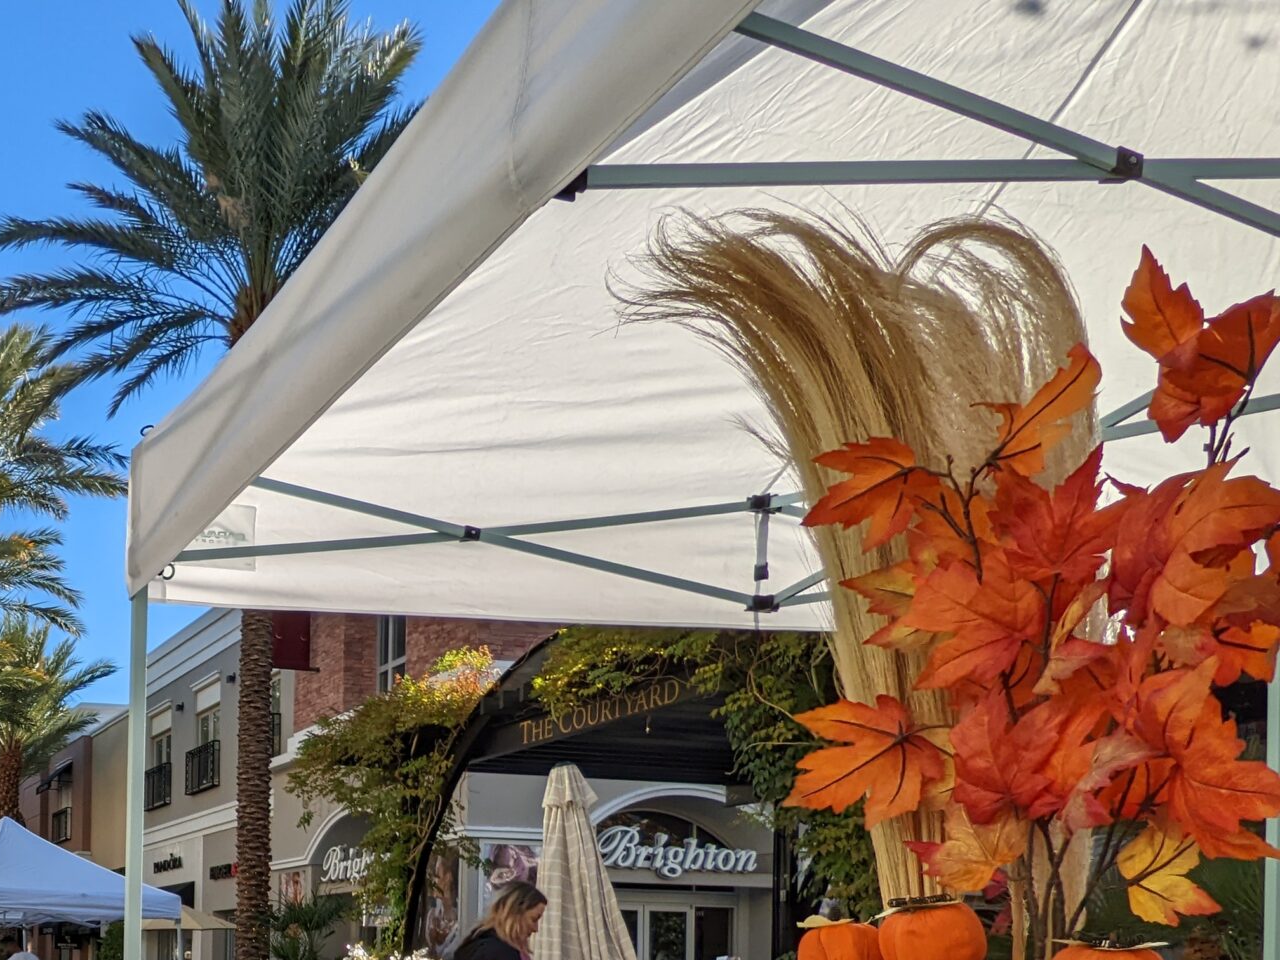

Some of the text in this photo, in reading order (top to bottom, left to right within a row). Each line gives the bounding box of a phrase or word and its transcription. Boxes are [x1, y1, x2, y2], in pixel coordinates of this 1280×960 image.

[521, 679, 679, 745] THE COURTYARD
[321, 845, 377, 886] Brigh
[598, 825, 757, 878] Brighton
